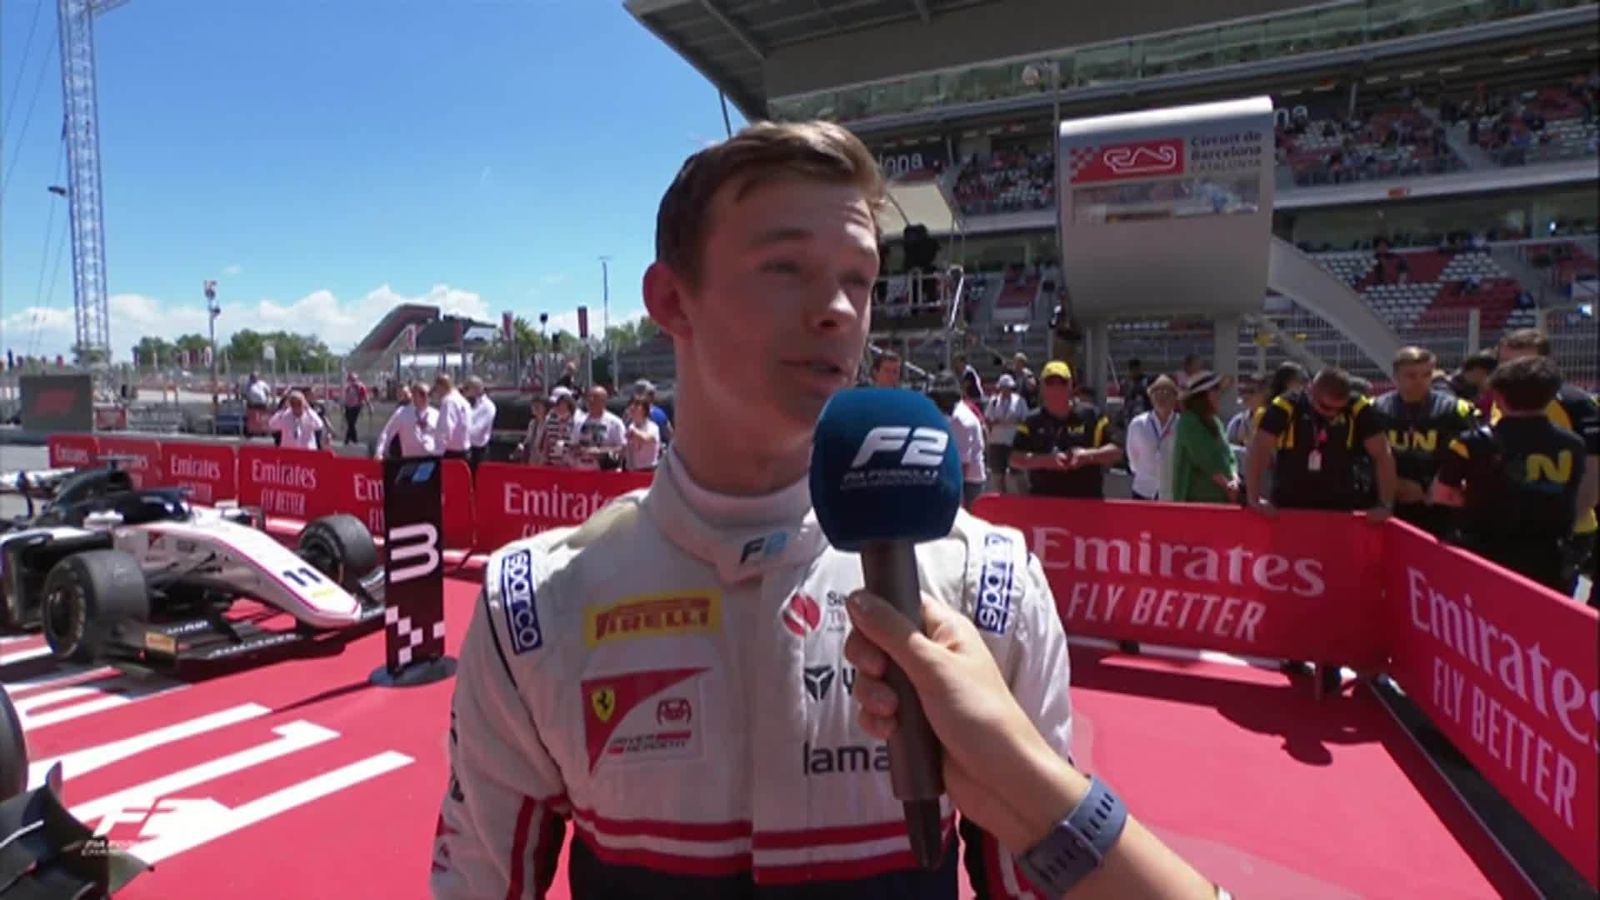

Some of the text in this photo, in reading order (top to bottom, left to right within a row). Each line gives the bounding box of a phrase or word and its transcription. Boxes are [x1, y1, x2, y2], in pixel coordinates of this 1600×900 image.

[1191, 145, 1262, 161] Barcelona
[851, 426, 948, 468] F2
[170, 455, 220, 480] Emirates
[252, 459, 316, 488] Emirates
[503, 481, 607, 520] Emirat
[389, 523, 439, 584] 3
[740, 532, 789, 563] F2
[1031, 526, 1326, 597] Emirates
[282, 567, 322, 587] 11
[506, 551, 542, 650] sparco
[595, 597, 711, 641] PIRELLI
[1067, 582, 1267, 642] FLY BETTER
[803, 740, 891, 775] lama
[1433, 656, 1577, 830] FLY BETTER
